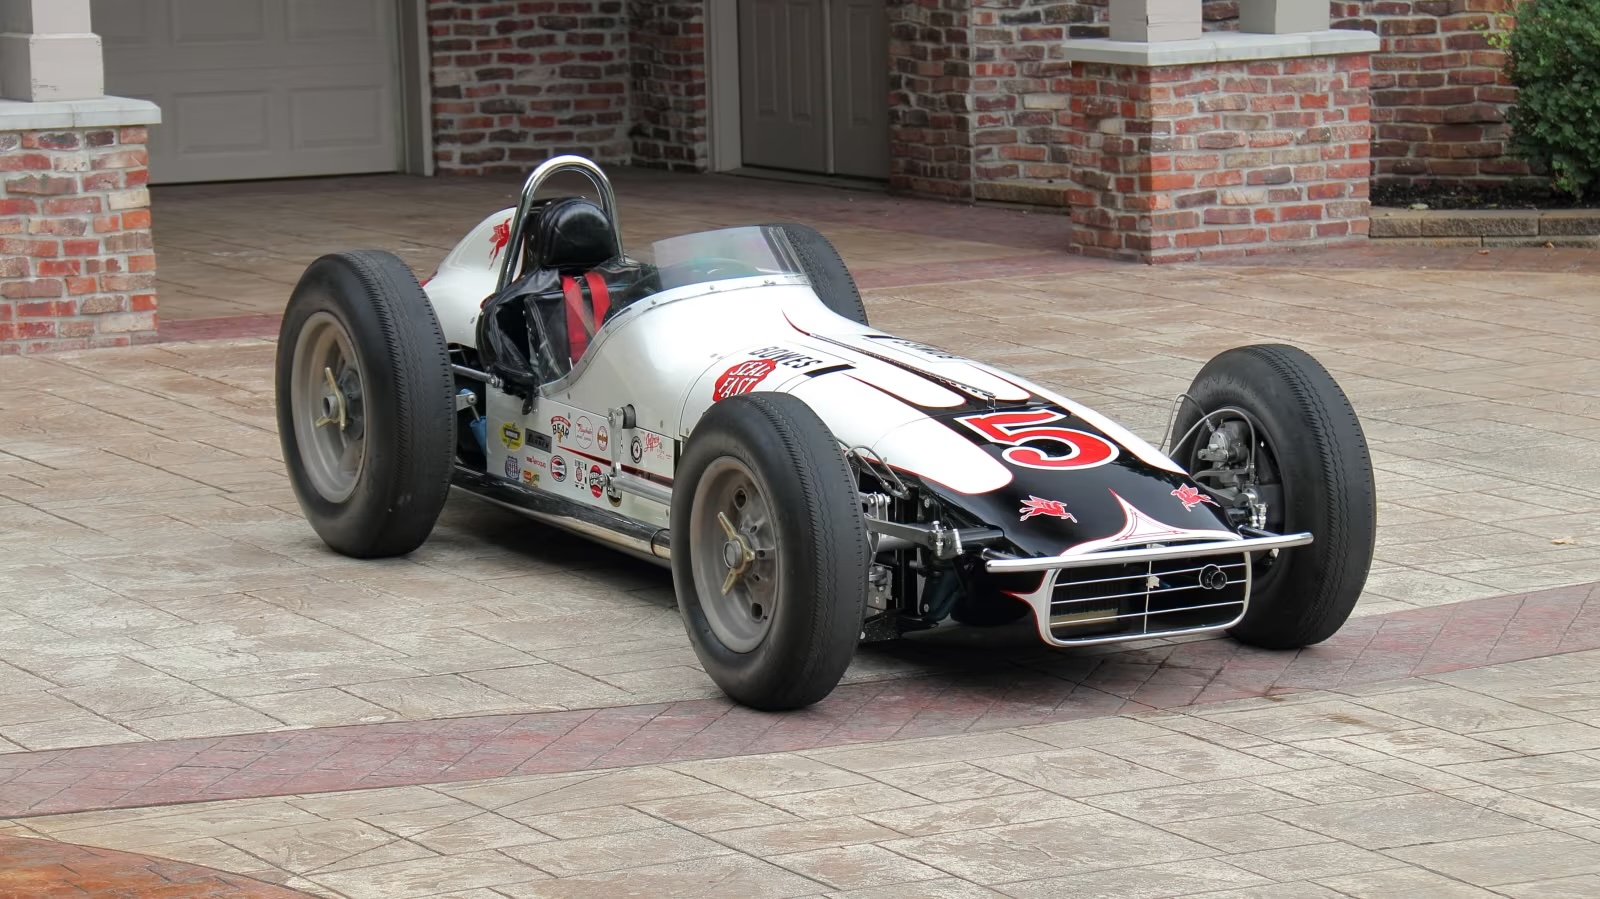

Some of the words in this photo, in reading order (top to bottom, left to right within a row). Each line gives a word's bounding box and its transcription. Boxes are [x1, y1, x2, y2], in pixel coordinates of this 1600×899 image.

[748, 346, 823, 369] BOWES
[729, 361, 771, 377] SEAL
[718, 377, 759, 398] FAST
[552, 423, 570, 439] BEAR
[953, 409, 1120, 471] 5
